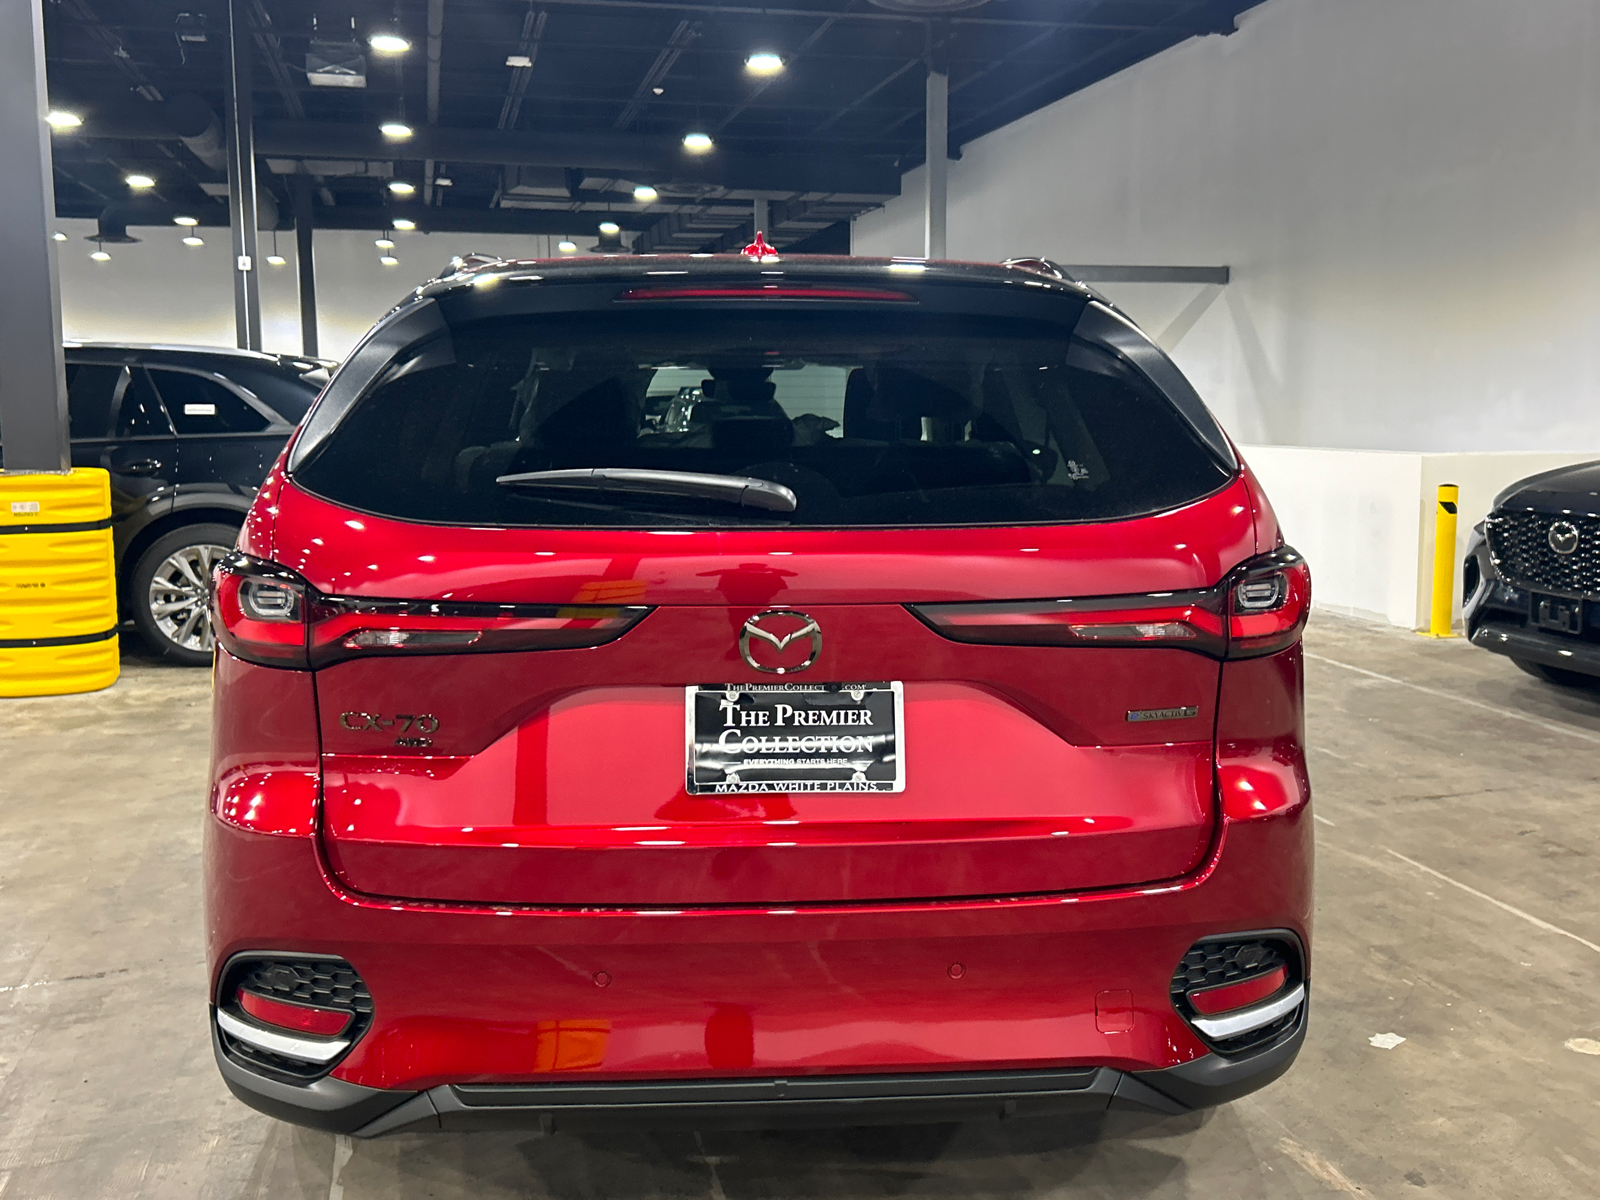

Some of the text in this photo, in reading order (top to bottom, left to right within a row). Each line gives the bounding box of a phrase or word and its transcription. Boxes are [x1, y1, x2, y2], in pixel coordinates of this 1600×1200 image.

[725, 683, 866, 691] THEPREMIERCOLLECT.COM
[339, 711, 440, 734] CX-70
[718, 704, 874, 727] THE PREMIER
[718, 729, 874, 754] COLLECTION
[743, 758, 848, 766] EVERYTHING STARTS HERE
[715, 782, 877, 793] MAZDA WHITE PLAINS
